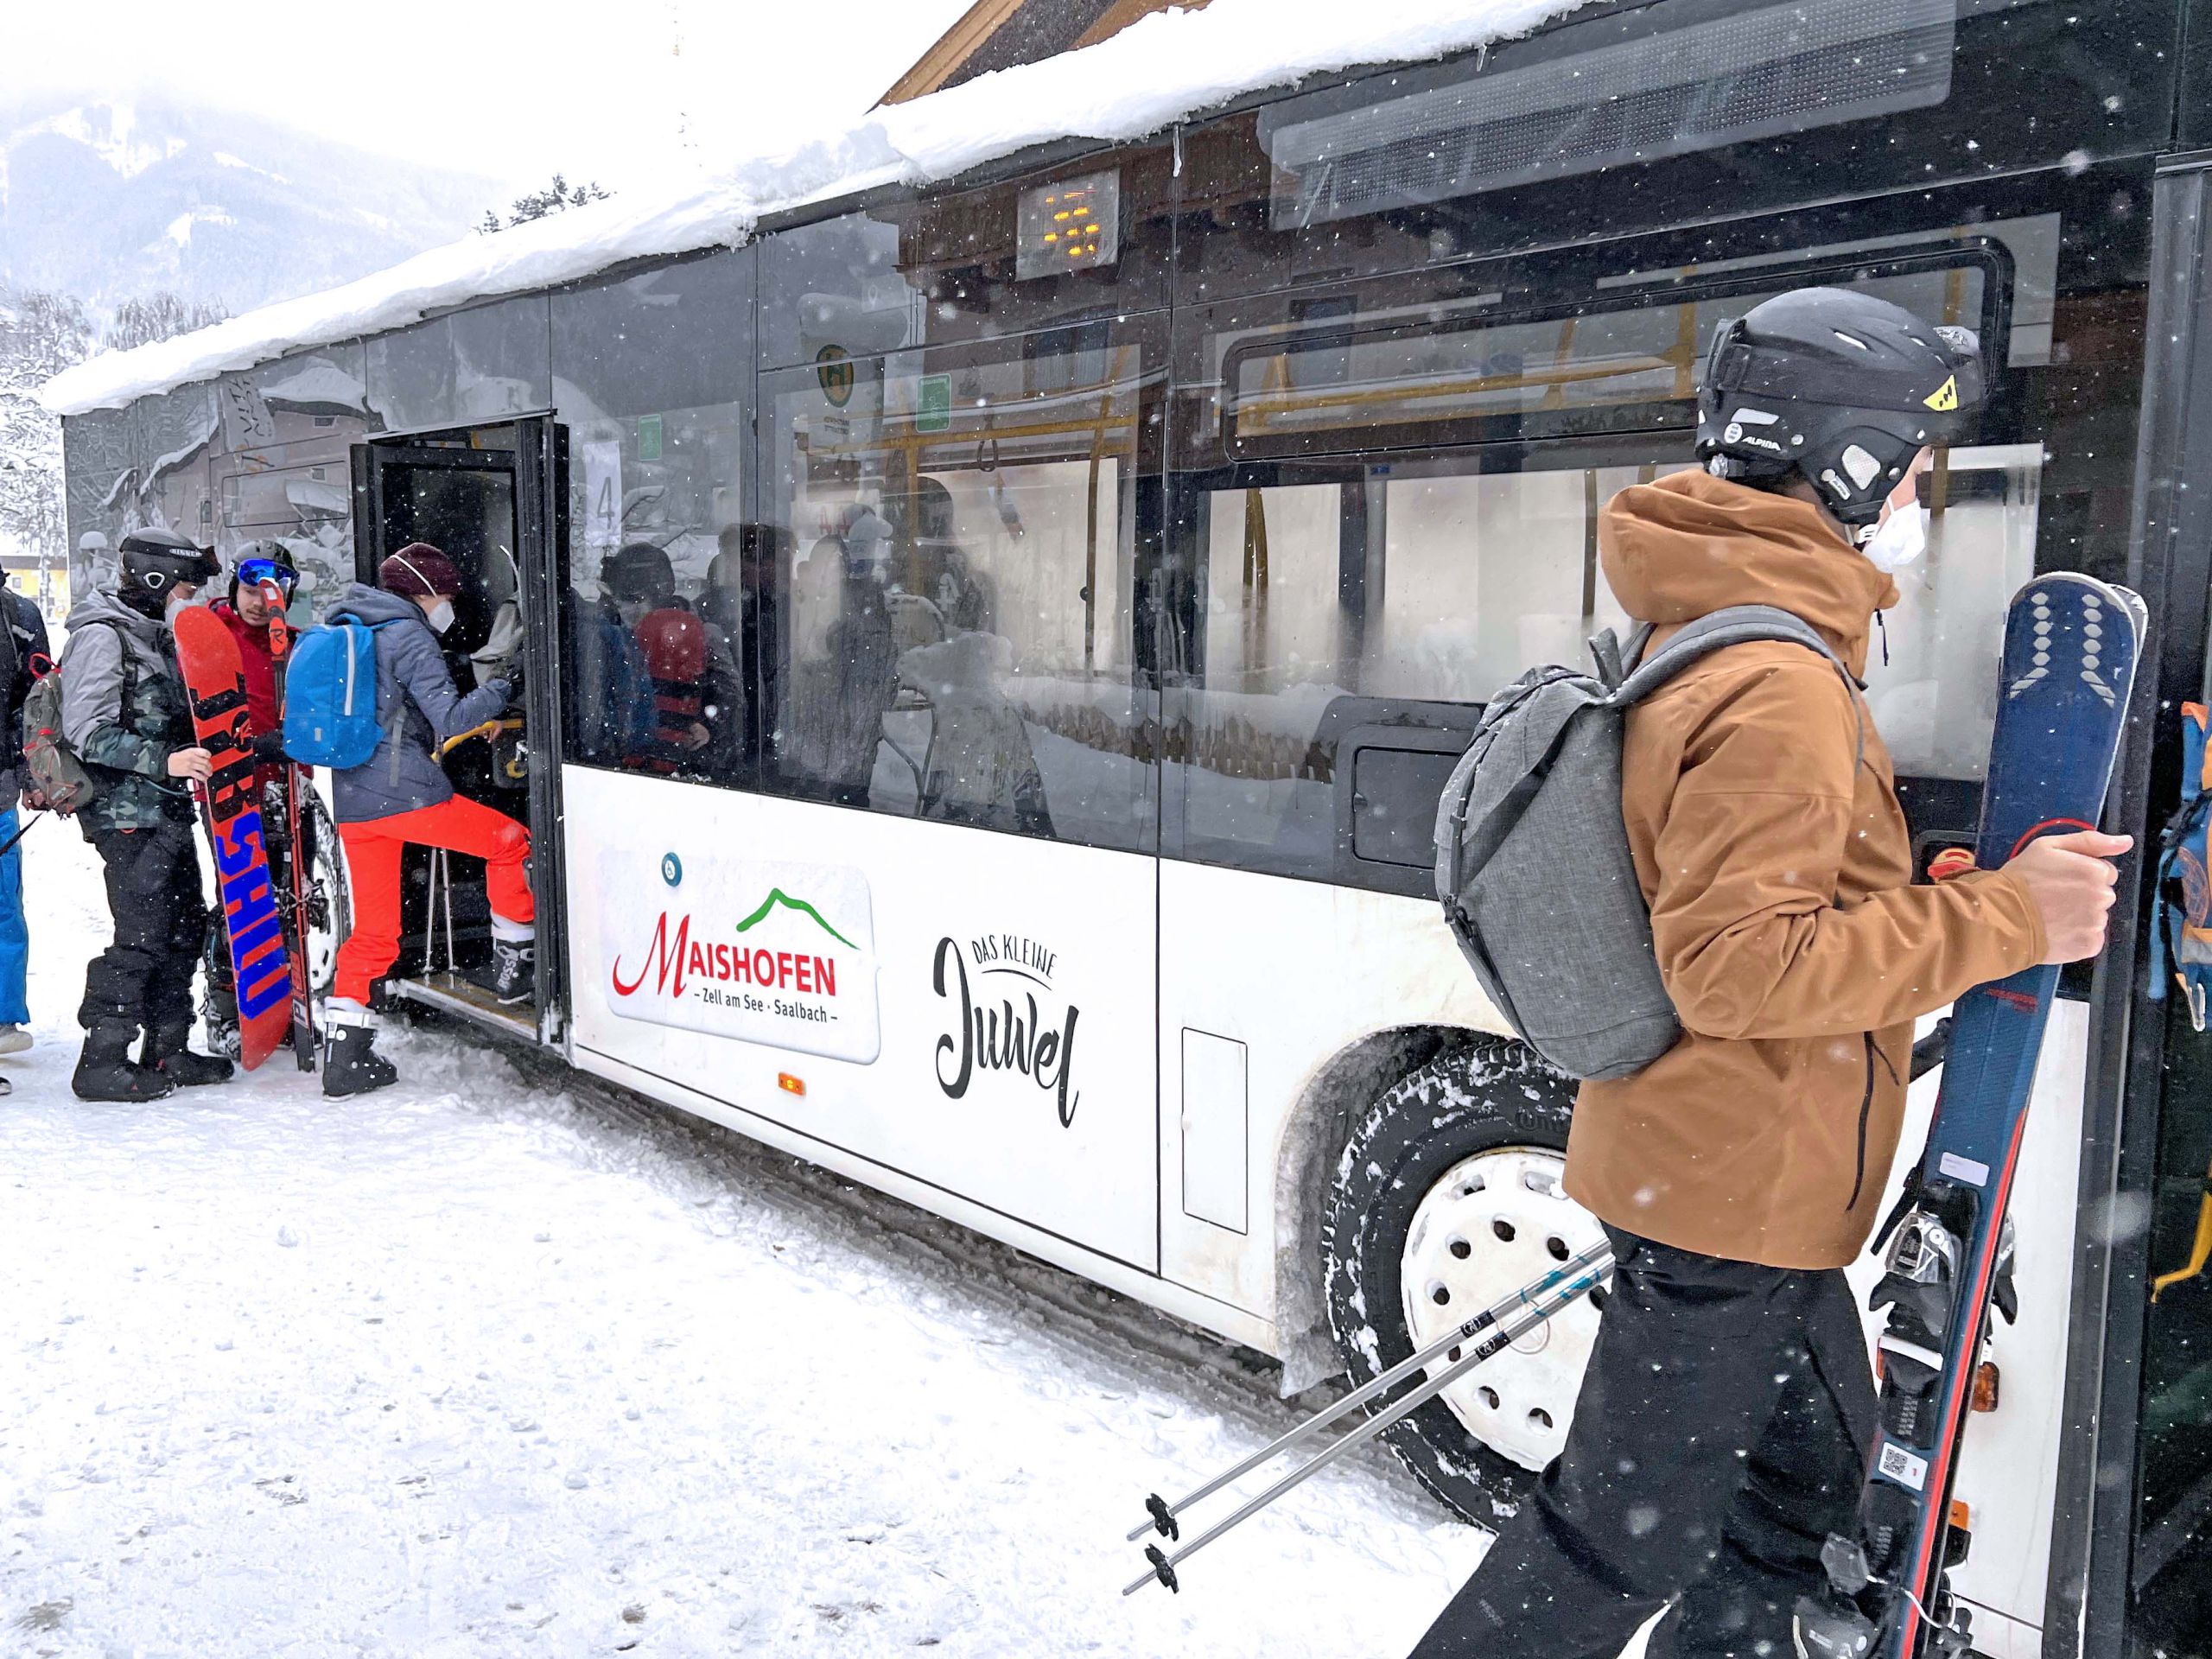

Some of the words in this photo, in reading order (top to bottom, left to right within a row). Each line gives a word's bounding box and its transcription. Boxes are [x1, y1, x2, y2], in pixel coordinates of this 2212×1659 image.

[1742, 436, 1782, 451] ALPINA
[596, 476, 615, 530] 4
[613, 911, 836, 999] MAISHOFEN
[971, 934, 998, 964] DAS
[1003, 934, 1058, 979] KLEINE
[702, 988, 722, 1004] Zell
[726, 995, 741, 1008] am
[744, 994, 764, 1012] See
[774, 999, 827, 1023] Saalbach
[933, 937, 1080, 1129] Juwel
